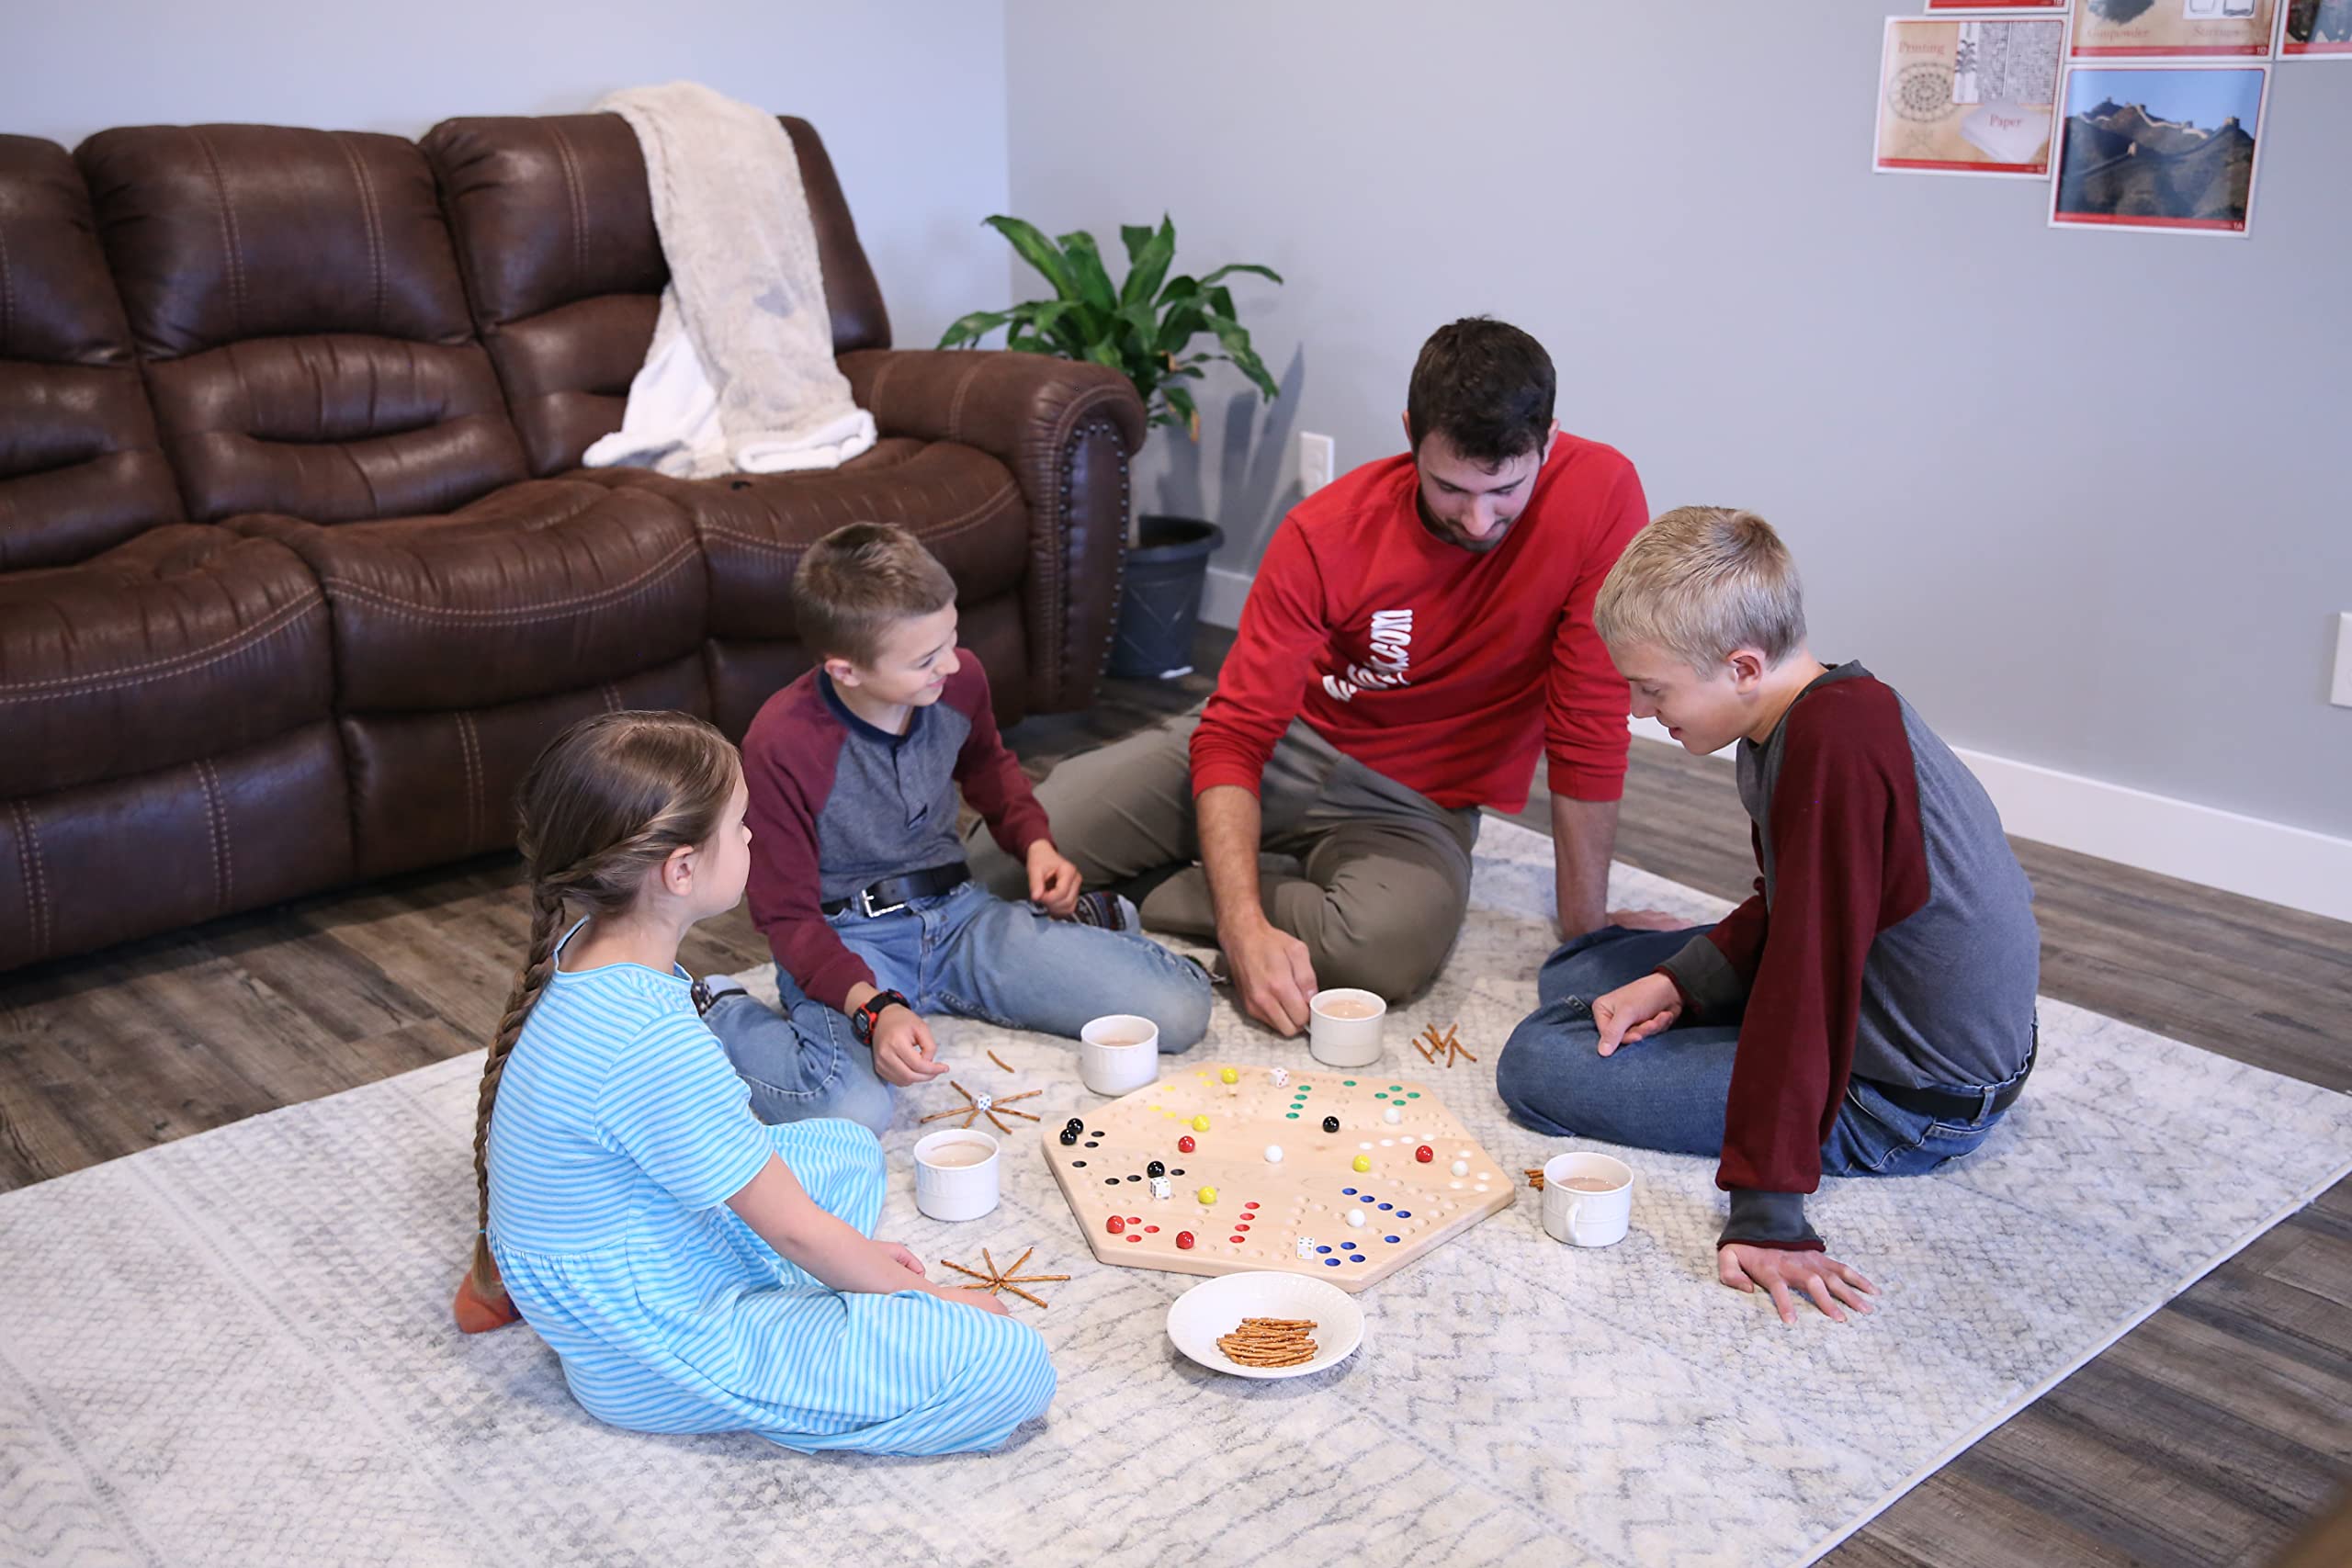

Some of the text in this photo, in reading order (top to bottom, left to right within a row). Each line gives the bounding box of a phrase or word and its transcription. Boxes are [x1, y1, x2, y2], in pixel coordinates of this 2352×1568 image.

[2087, 28, 2150, 41] Gunpowder
[1898, 40, 1945, 55] Printing
[1990, 114, 2022, 130] Paper
